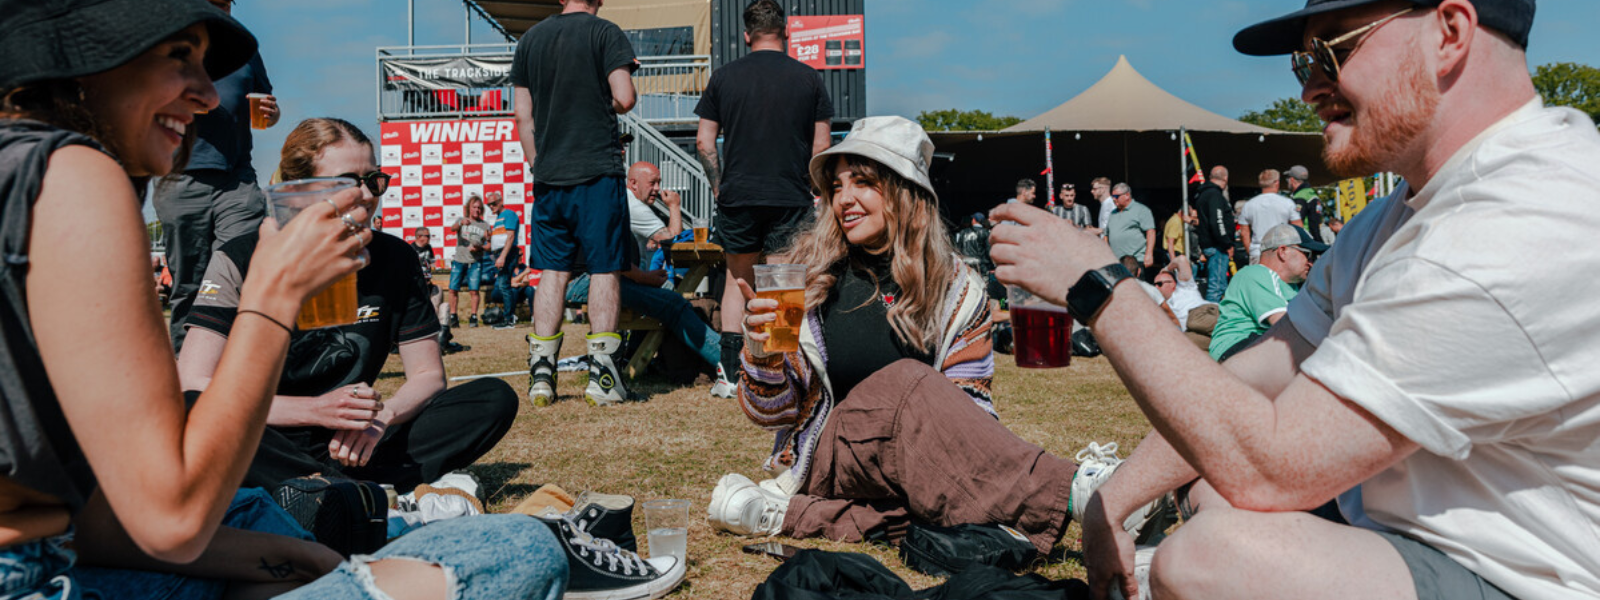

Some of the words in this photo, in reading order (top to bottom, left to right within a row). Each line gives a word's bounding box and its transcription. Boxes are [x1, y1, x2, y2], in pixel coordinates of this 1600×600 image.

[420, 67, 439, 80] THE
[445, 66, 510, 79] TRACKSIDE
[410, 120, 515, 144] WINNER
